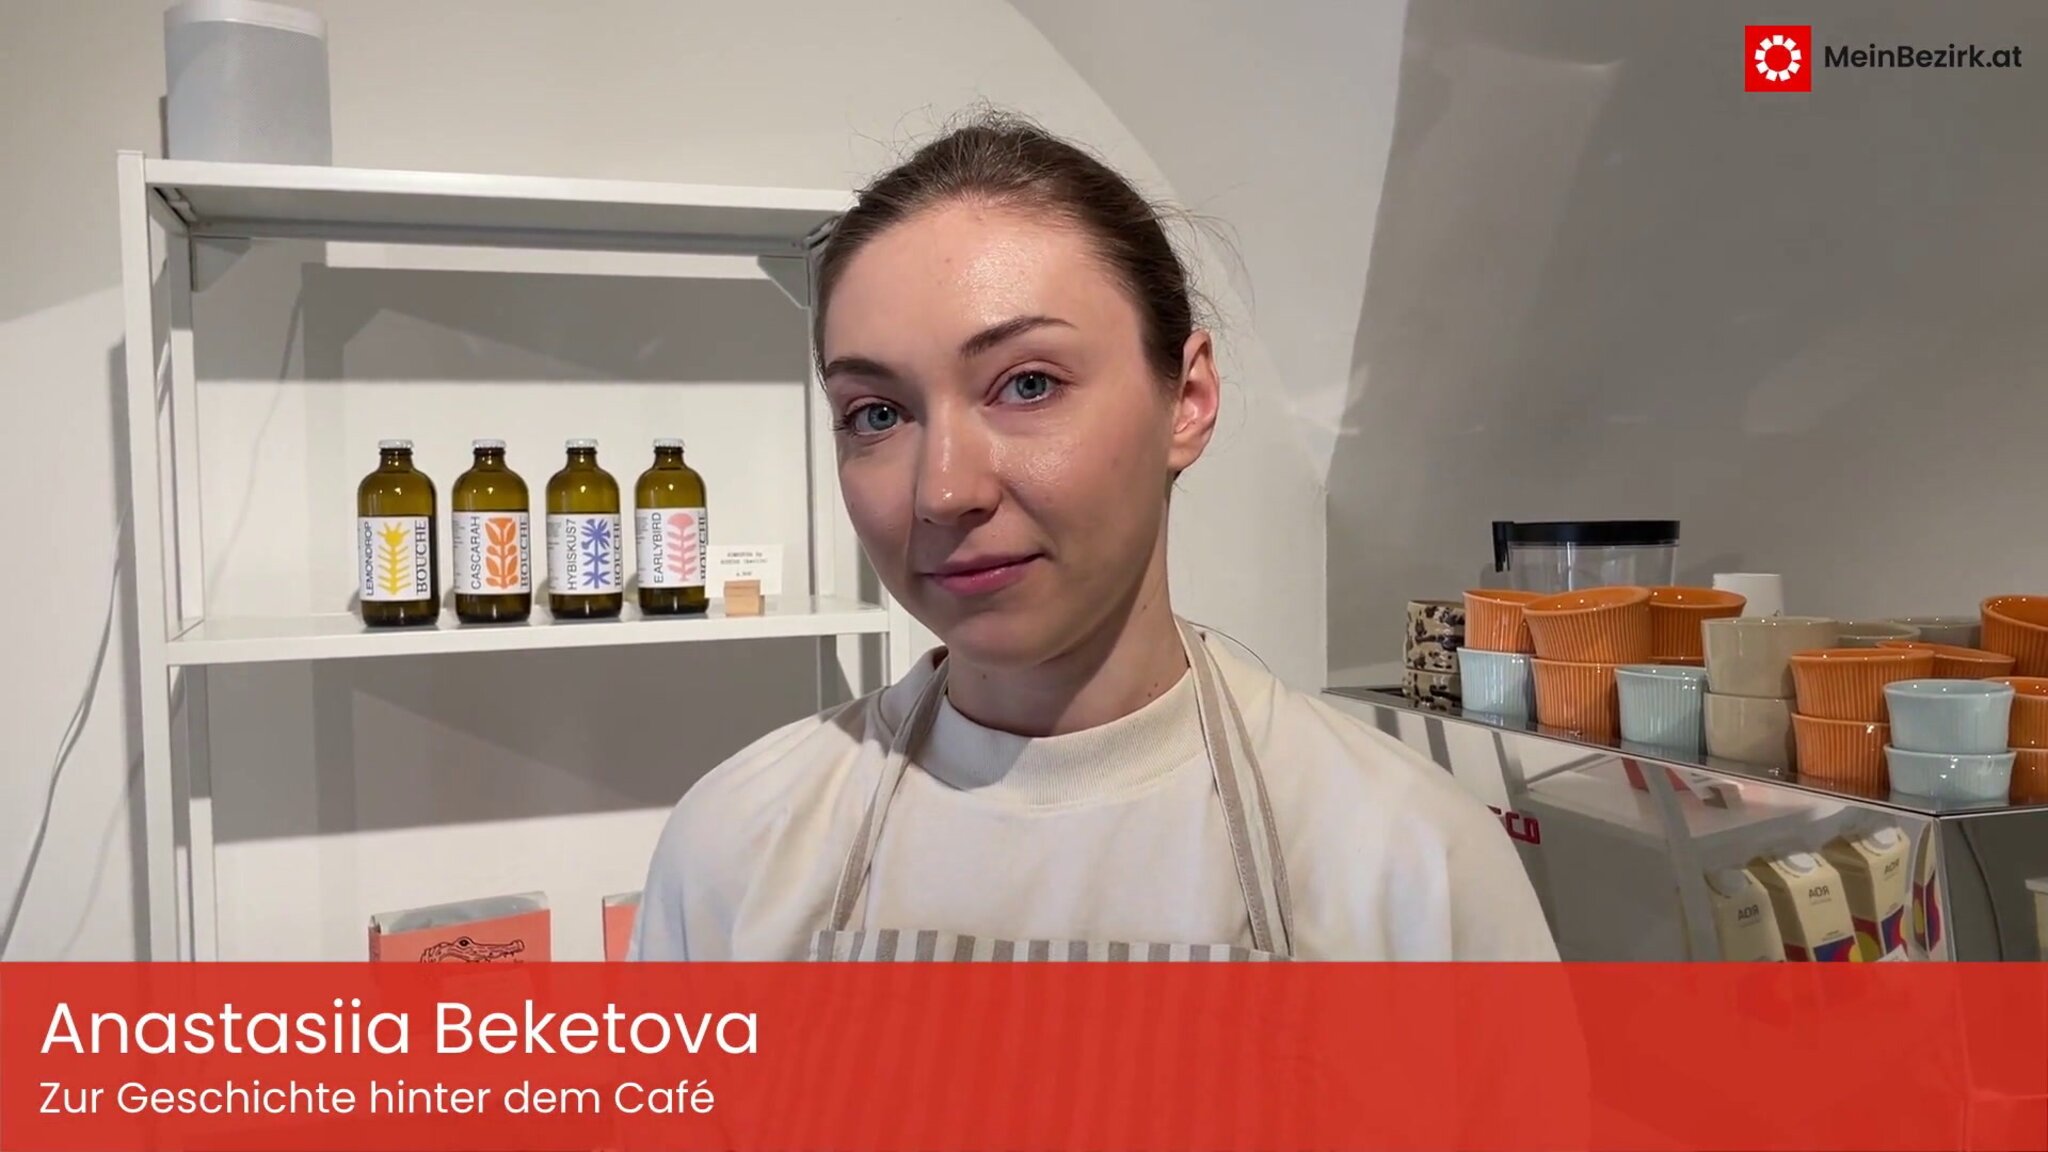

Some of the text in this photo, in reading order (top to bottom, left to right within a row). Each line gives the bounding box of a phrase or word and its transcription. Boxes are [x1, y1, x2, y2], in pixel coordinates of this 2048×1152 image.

[364, 521, 374, 597] LEMONDROP
[415, 520, 428, 595] BOUCHE
[470, 516, 481, 590] CASCARAH
[520, 516, 529, 587] BOUCHE
[566, 519, 577, 590] HYBISKUS7
[652, 512, 663, 584] EARLYBIRD
